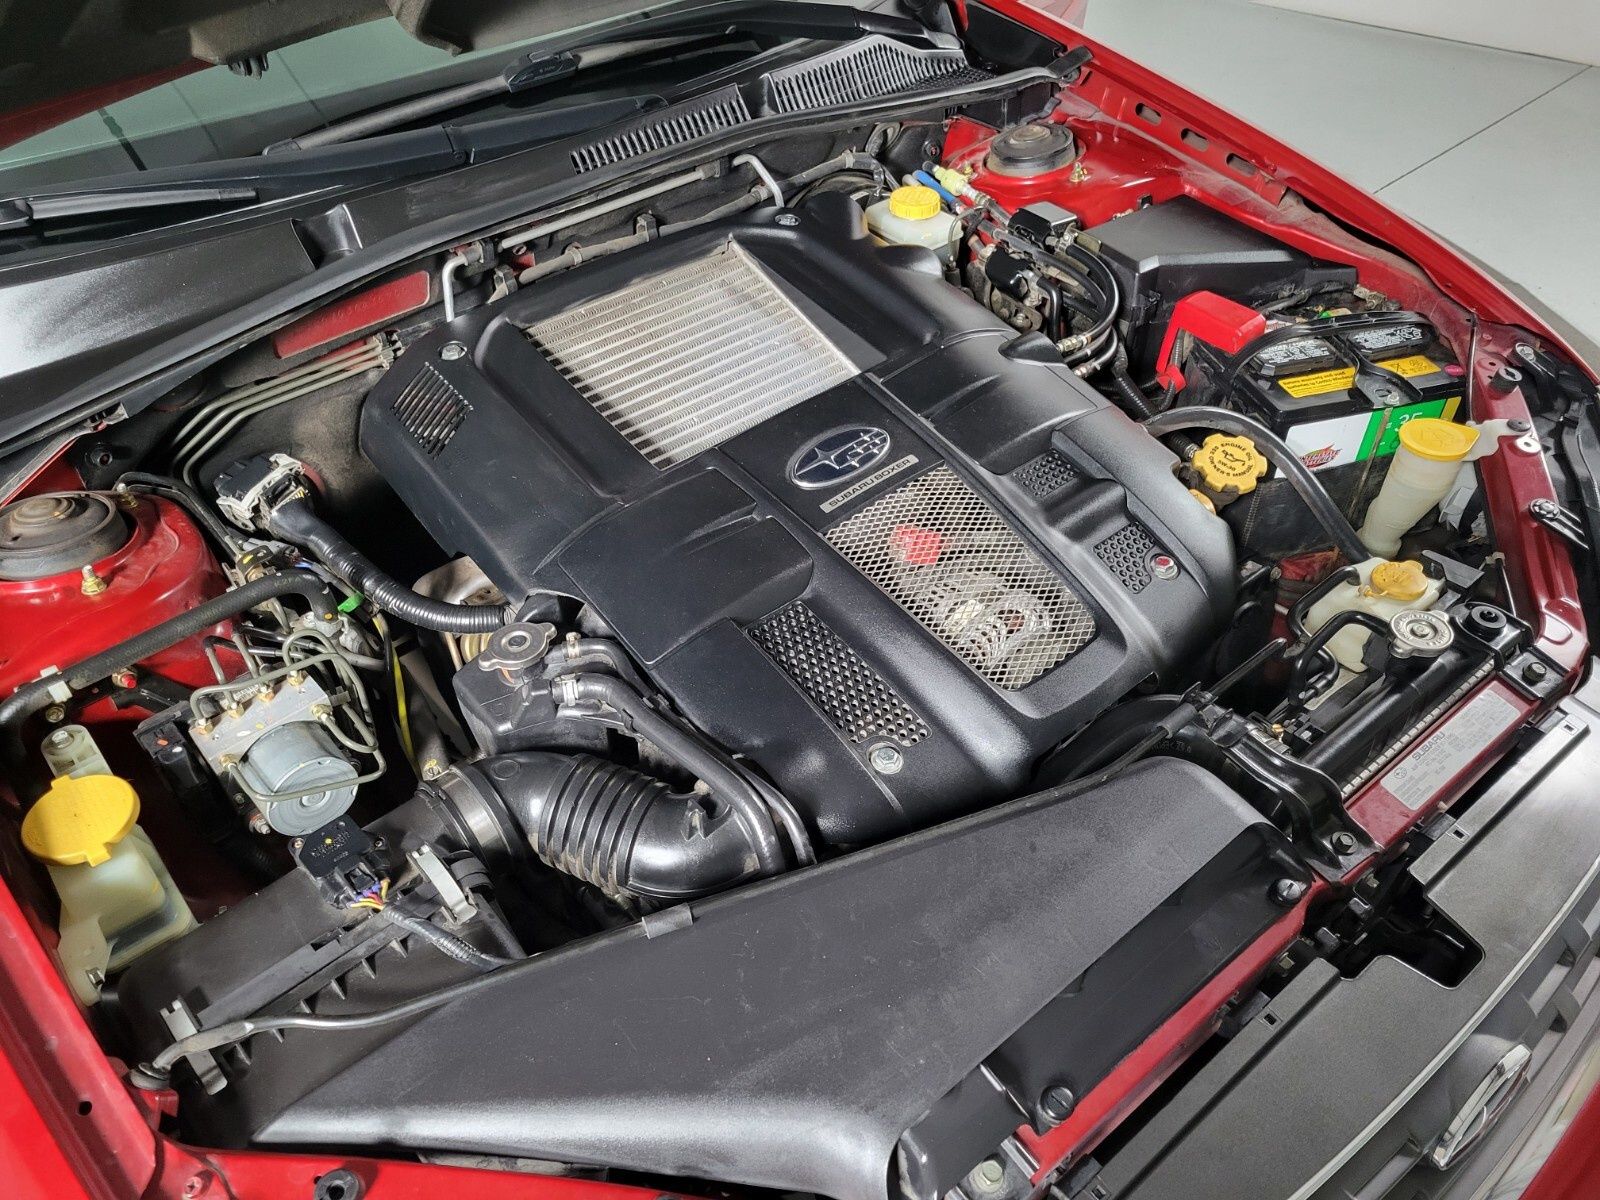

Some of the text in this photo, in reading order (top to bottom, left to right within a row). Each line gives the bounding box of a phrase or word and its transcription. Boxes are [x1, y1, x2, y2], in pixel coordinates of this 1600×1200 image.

[1220, 442, 1246, 452] ENGINE
[829, 459, 911, 507] SUBARU BOXER
[1411, 730, 1446, 761] SUBARU
